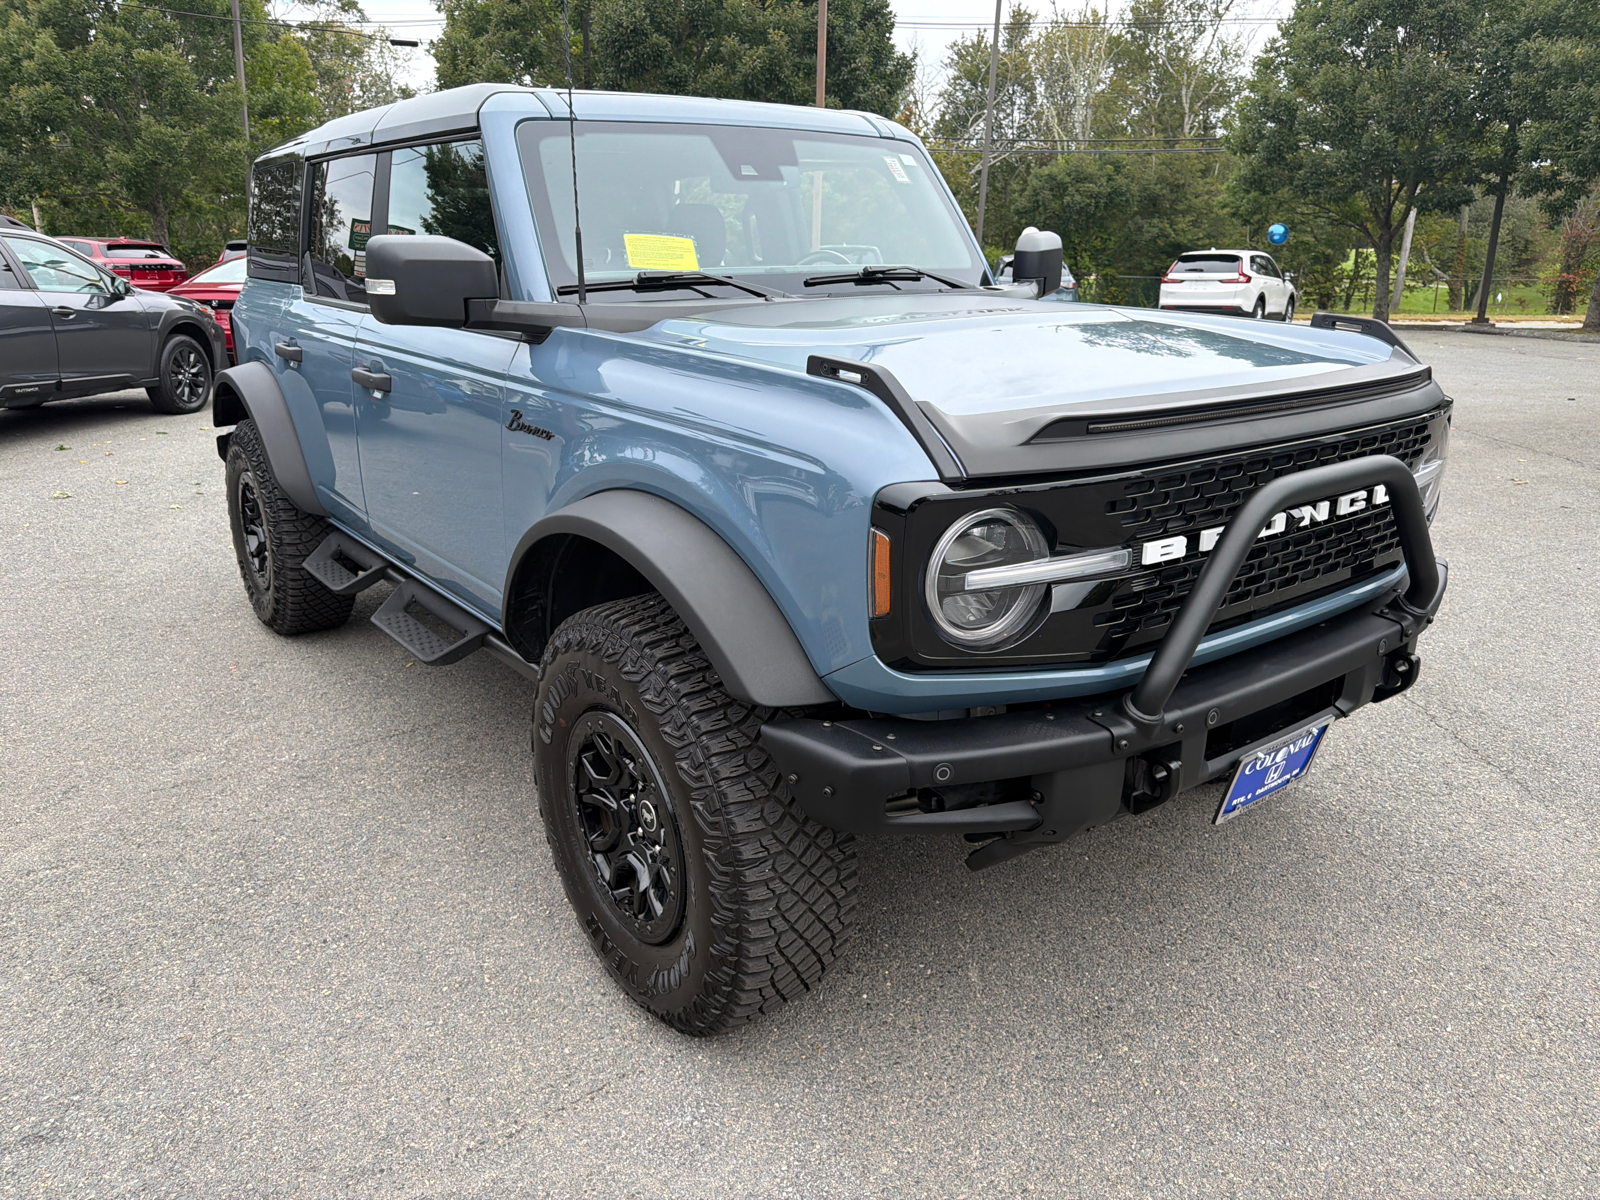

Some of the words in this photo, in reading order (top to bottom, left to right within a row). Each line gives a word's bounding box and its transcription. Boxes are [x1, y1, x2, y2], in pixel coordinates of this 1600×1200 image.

[505, 409, 555, 441] Bronco
[538, 660, 640, 745] GOODYEAR
[1244, 733, 1316, 775] COLONIAL
